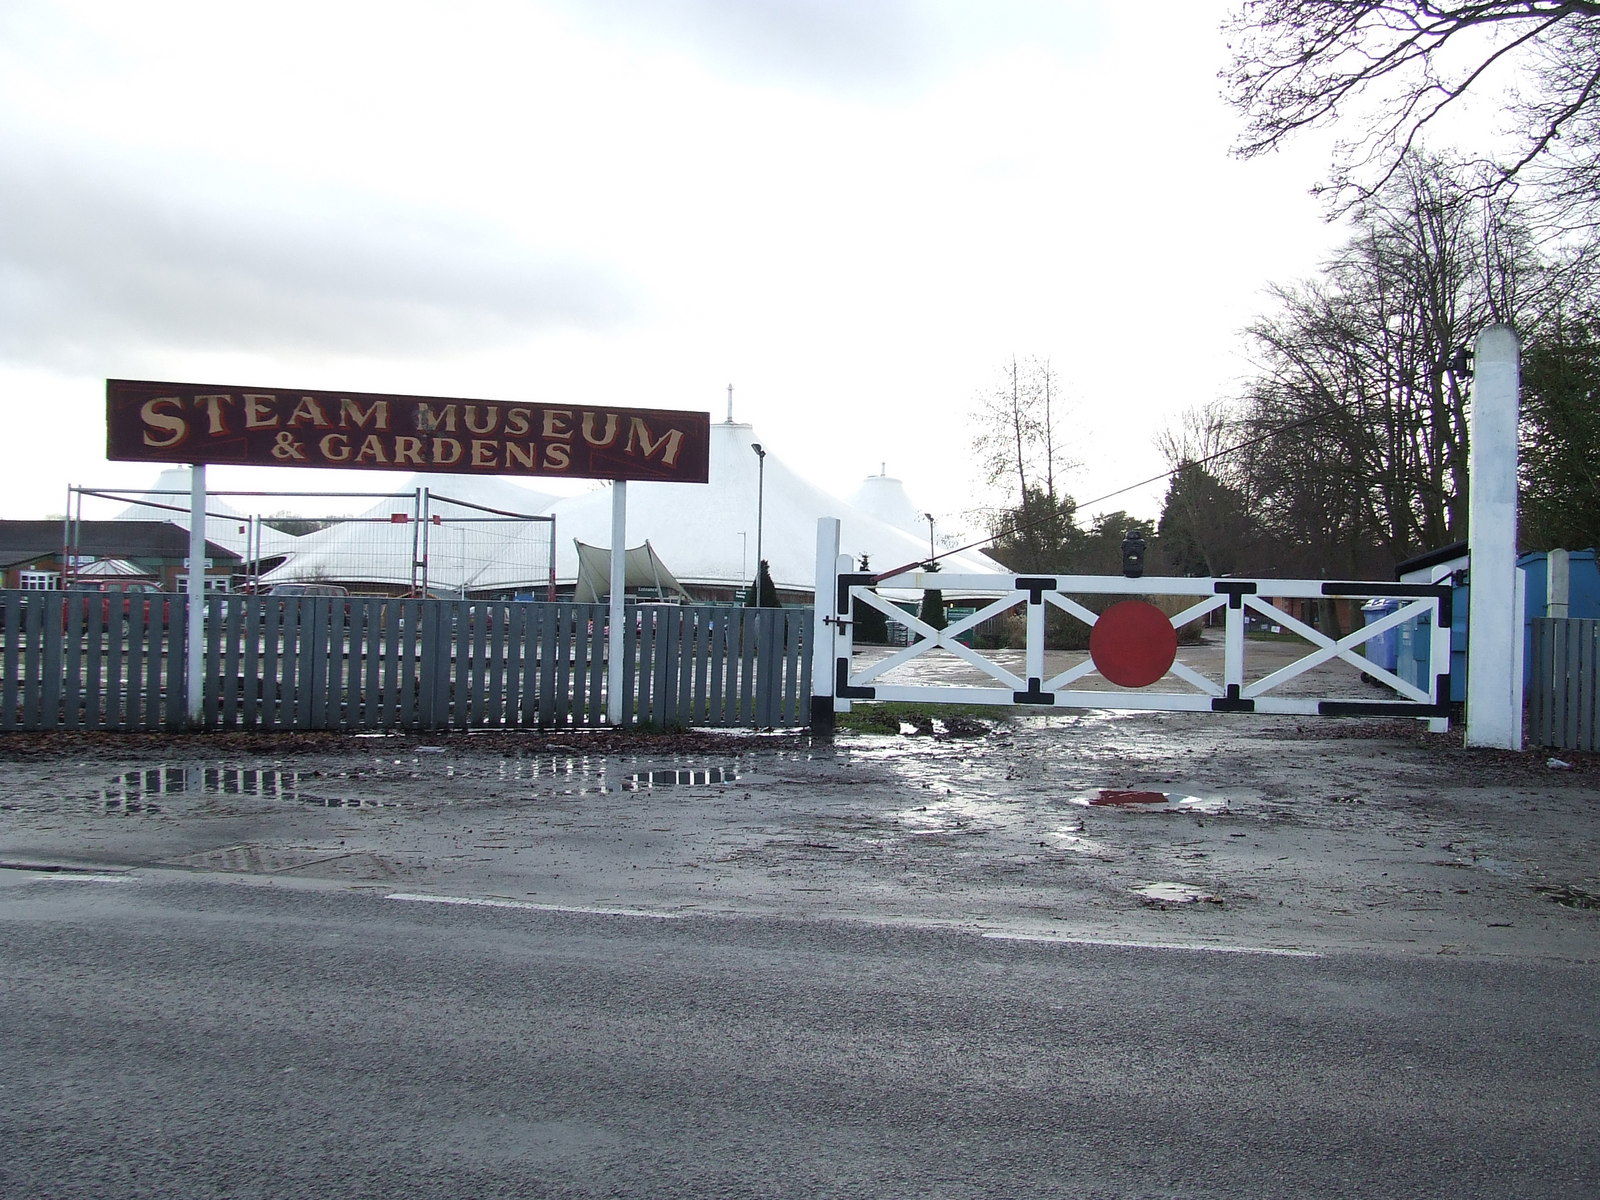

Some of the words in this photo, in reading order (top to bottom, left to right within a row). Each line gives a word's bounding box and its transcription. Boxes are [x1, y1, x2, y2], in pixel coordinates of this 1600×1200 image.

[140, 394, 388, 447] STEAM
[416, 403, 685, 465] MUSEUM
[271, 431, 305, 459] &
[319, 433, 571, 469] GARDENS
